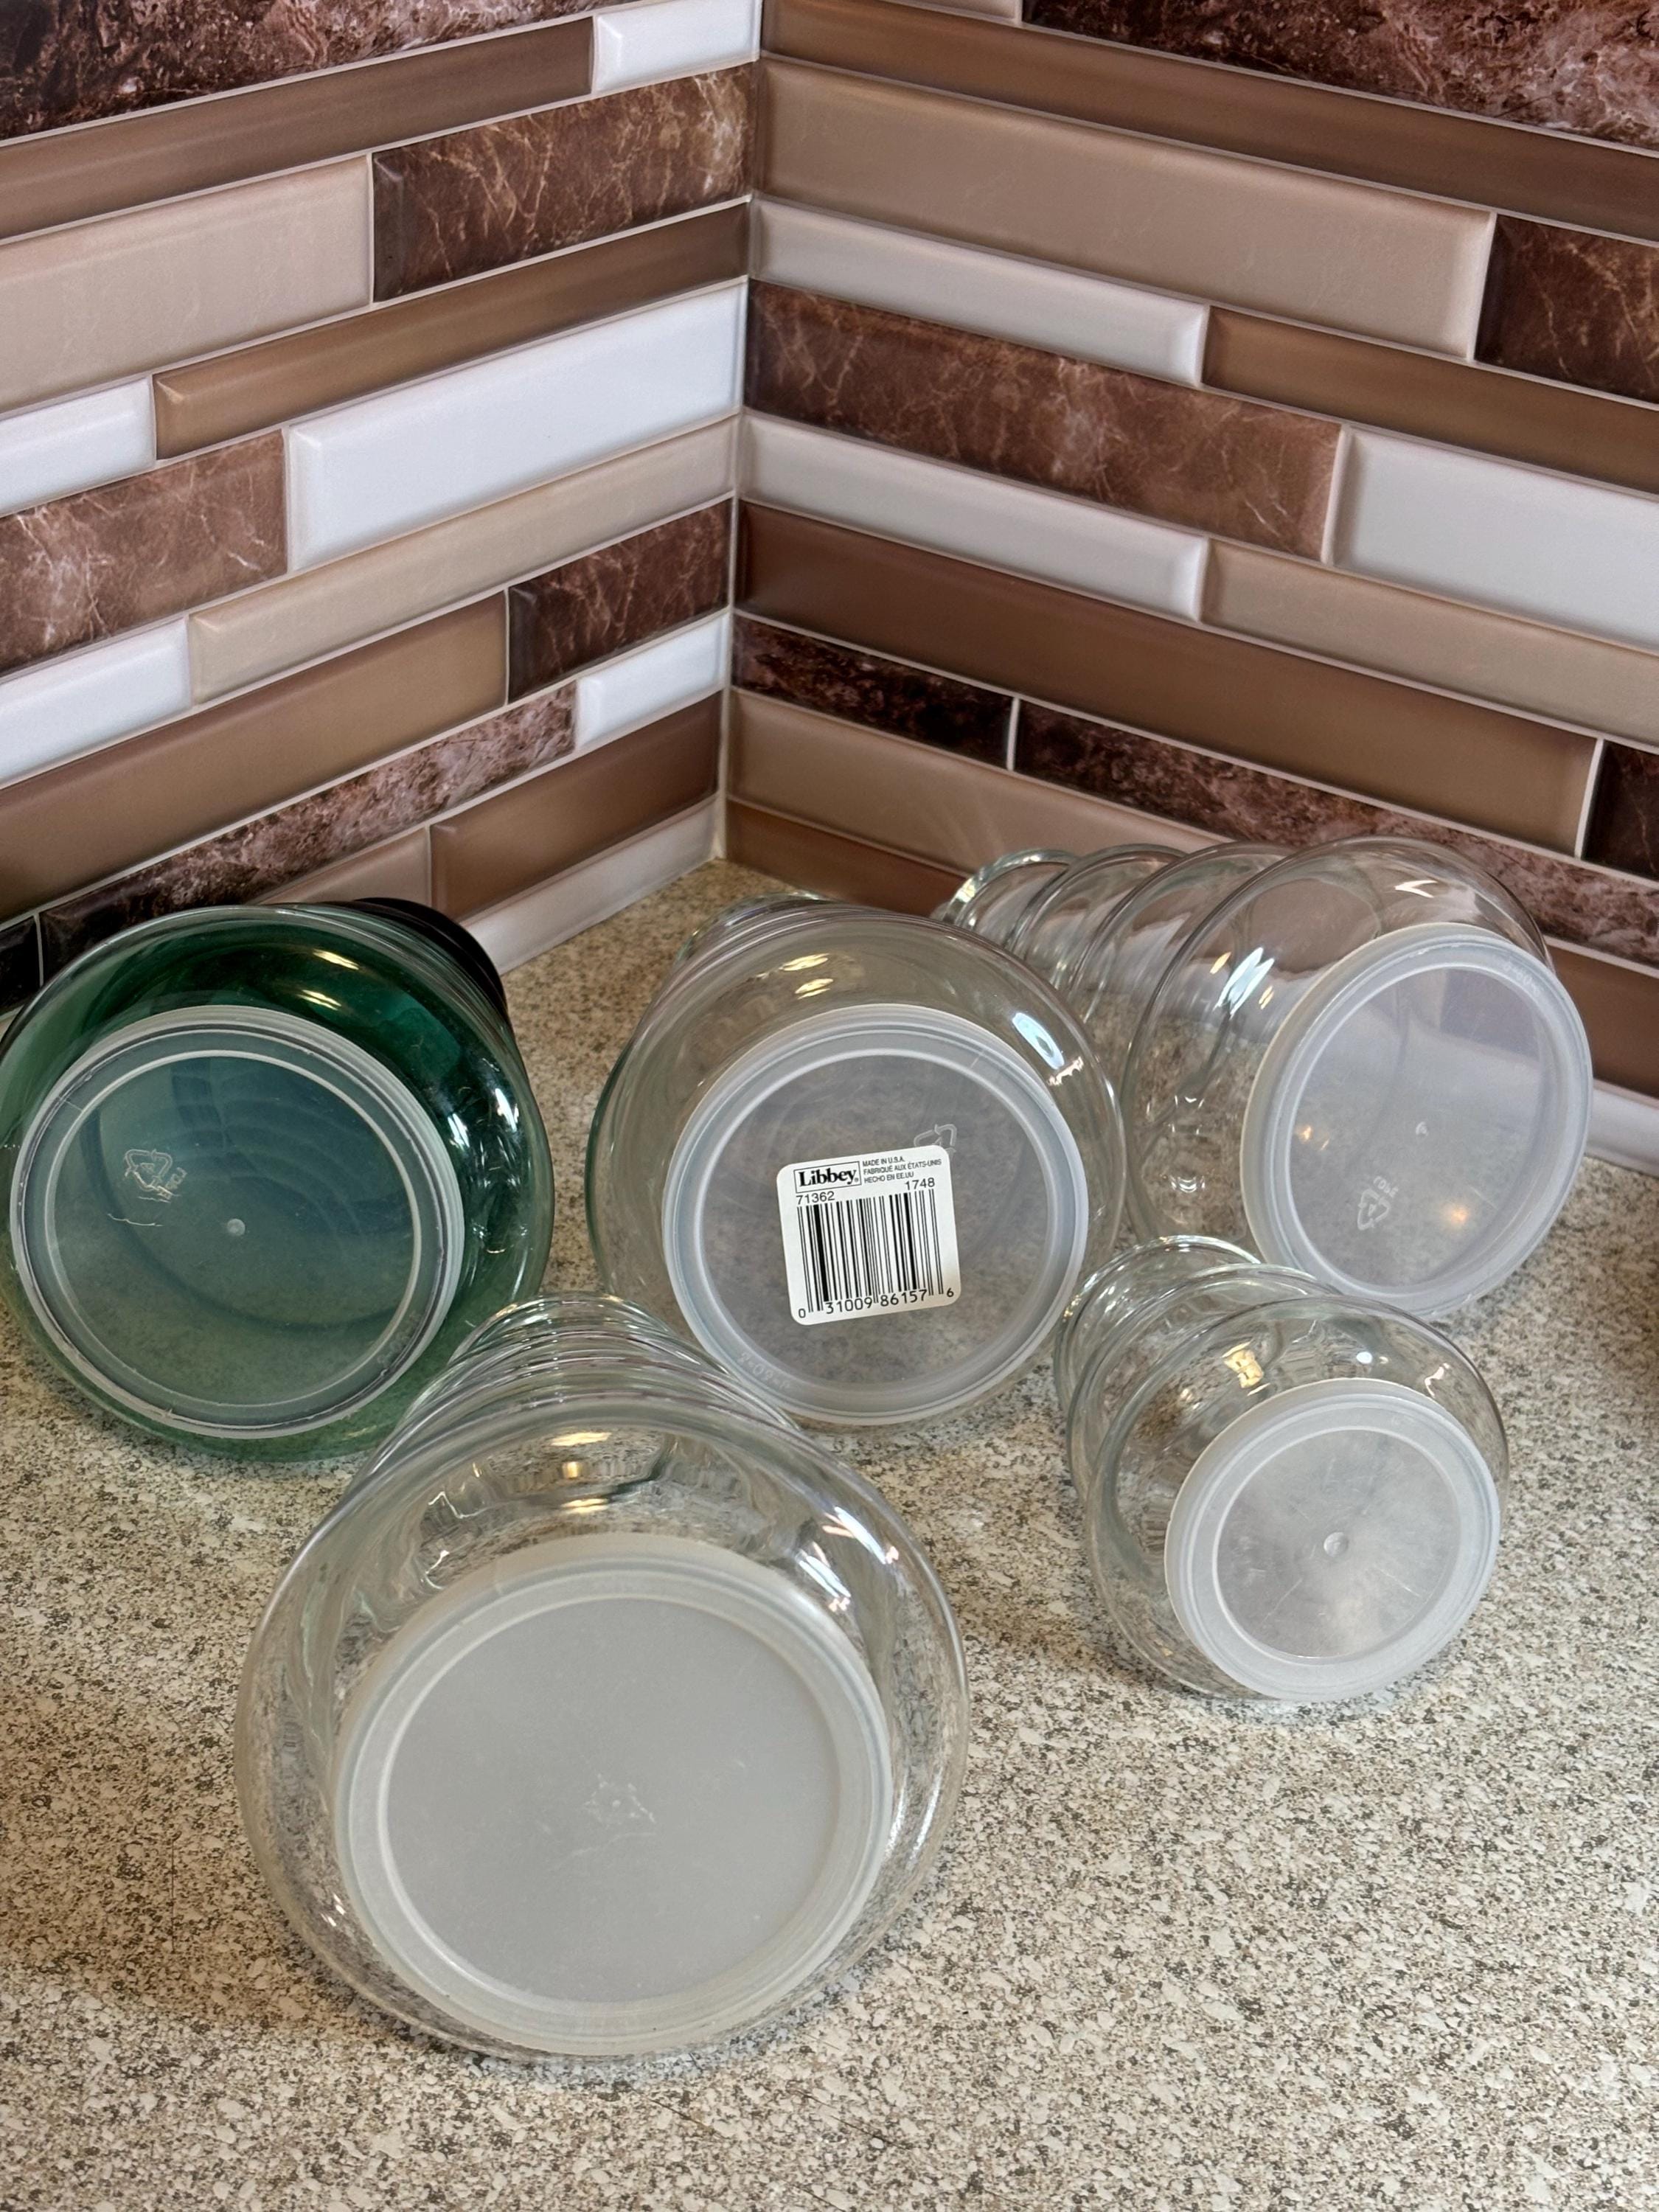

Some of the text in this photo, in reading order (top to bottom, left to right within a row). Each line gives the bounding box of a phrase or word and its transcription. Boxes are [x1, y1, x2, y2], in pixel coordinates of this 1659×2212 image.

[862, 1158, 880, 1167] MADE
[894, 1163, 907, 1171] AUX
[907, 1158, 942, 1169] ÉTATS-UNIS
[799, 1167, 857, 1187] Libbey
[863, 1175, 886, 1184] HECHO
[905, 1178, 935, 1191] 1748
[796, 1191, 835, 1205] 71362
[798, 1287, 954, 1318] 0 31009 86157 6
